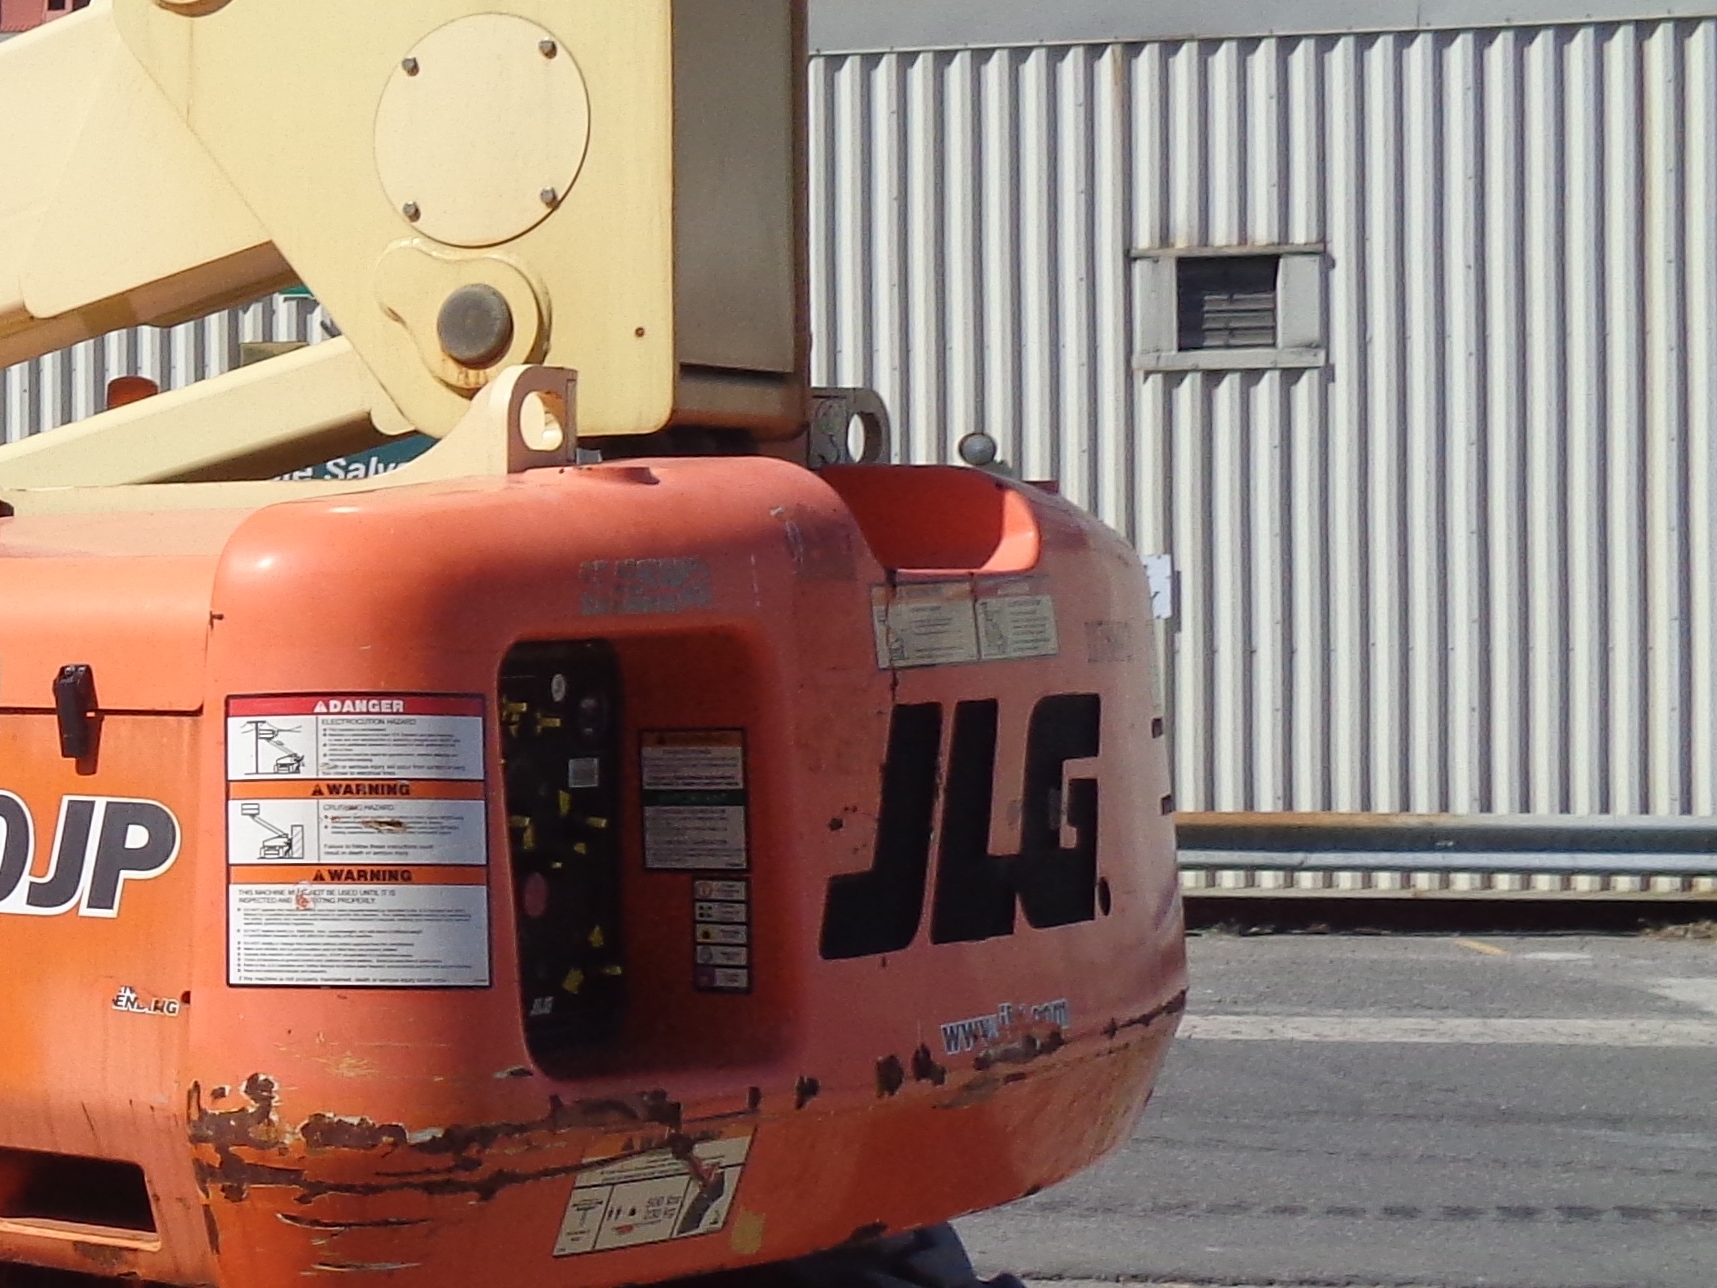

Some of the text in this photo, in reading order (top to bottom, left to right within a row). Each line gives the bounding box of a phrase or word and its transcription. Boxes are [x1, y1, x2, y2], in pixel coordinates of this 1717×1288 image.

[324, 456, 405, 481] Salv
[331, 699, 405, 713] DANGER
[327, 783, 411, 796] WARNING
[327, 869, 413, 882] WARNING
